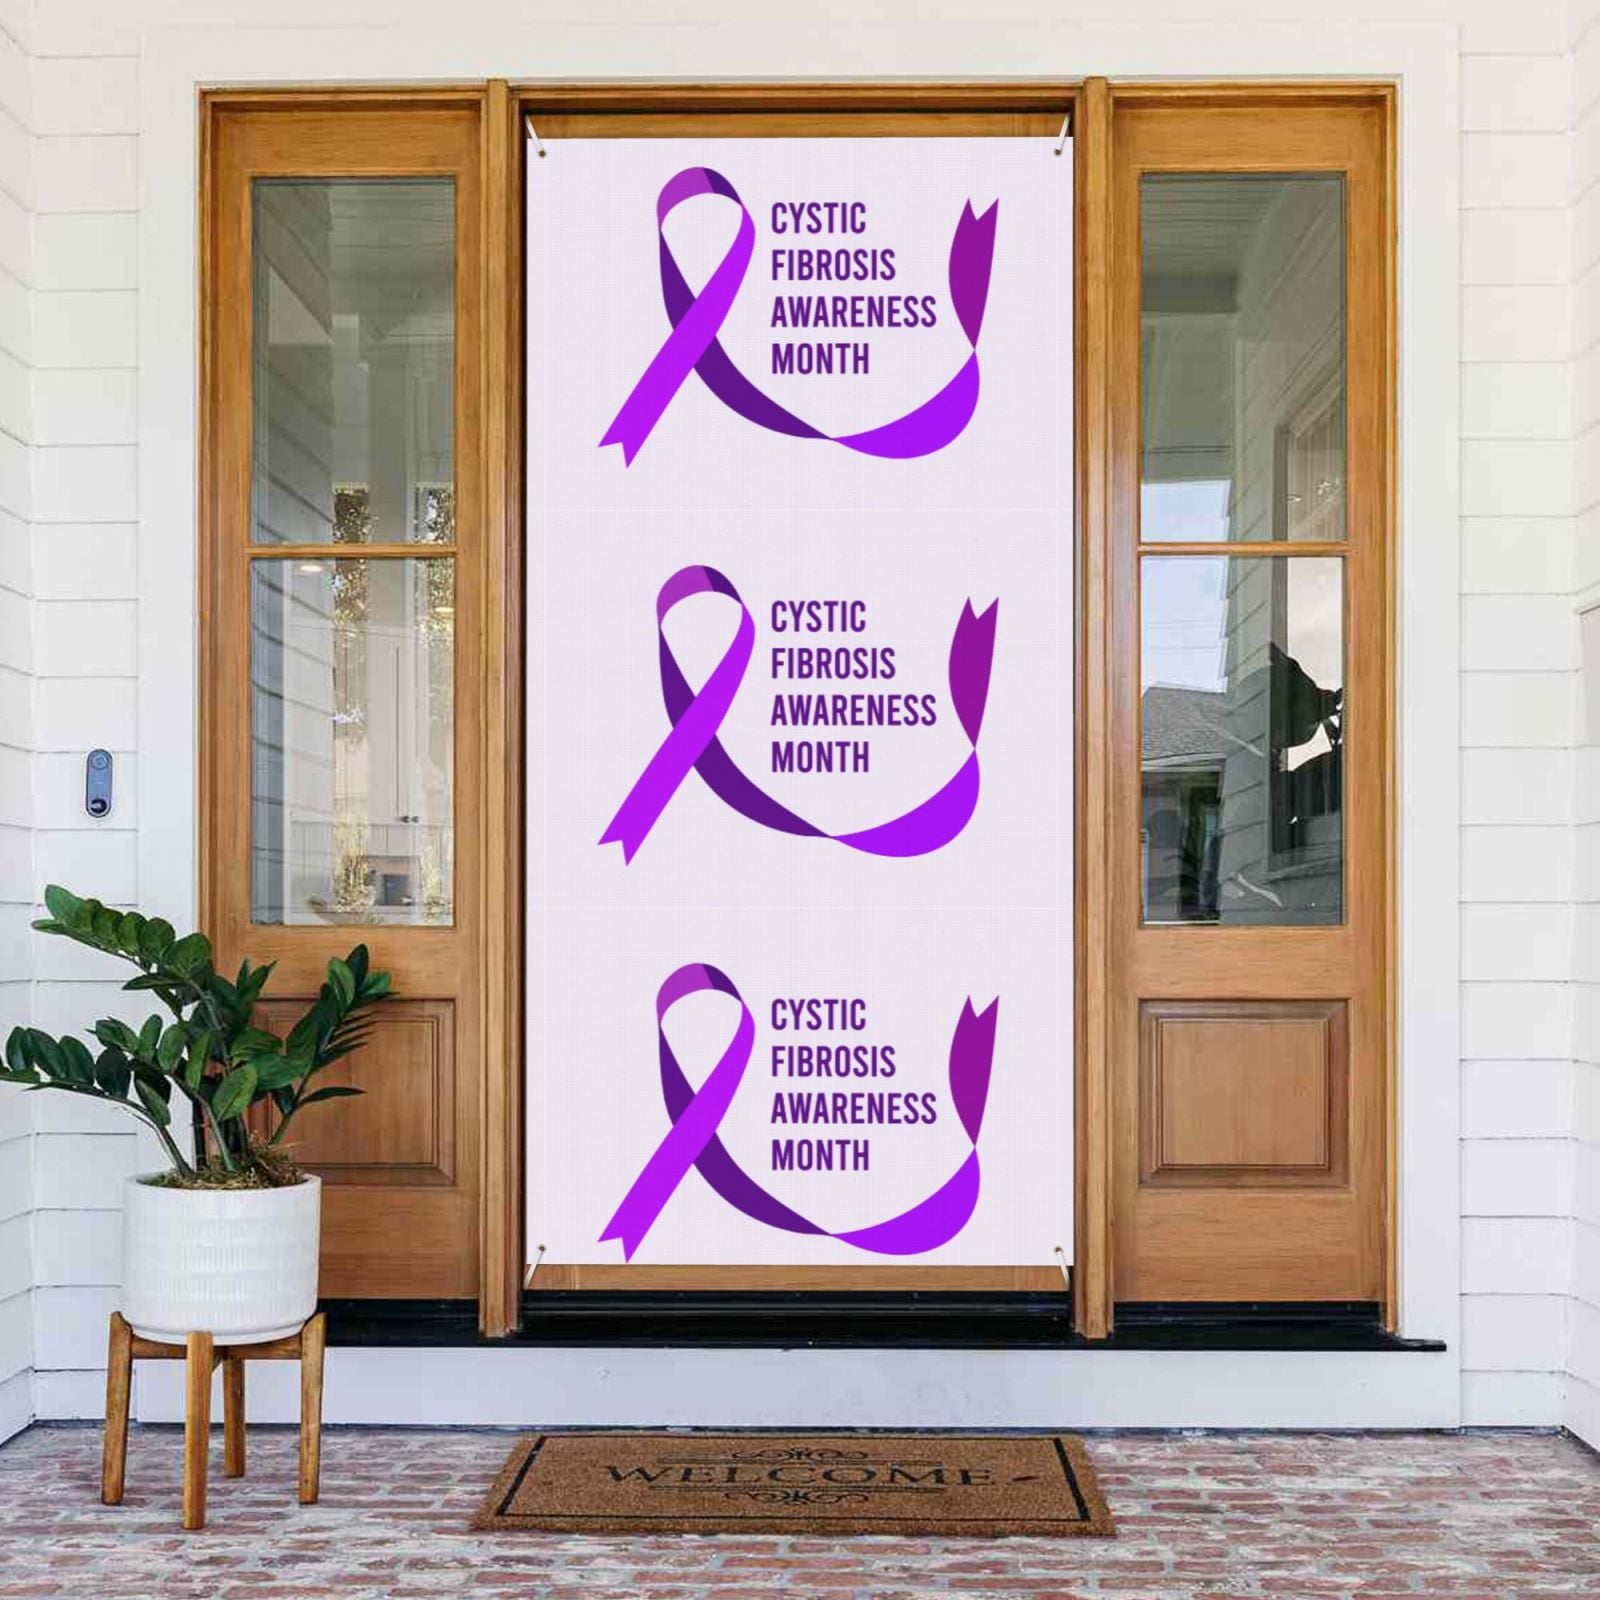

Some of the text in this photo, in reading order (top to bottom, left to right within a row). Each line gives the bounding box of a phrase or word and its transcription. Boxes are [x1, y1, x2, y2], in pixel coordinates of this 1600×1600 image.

[771, 201, 866, 235] CYSTIC
[772, 248, 896, 281] FIBROSIS
[771, 295, 937, 328] AWARENESS
[772, 342, 869, 375] MONTH
[771, 600, 866, 633] CYSTIC
[771, 647, 896, 680] FIBROSIS
[770, 694, 937, 727] AWARENESS
[771, 741, 869, 773] MONTH
[771, 998, 866, 1031] CYSTIC
[771, 1045, 896, 1078] FIBROSIS
[770, 1092, 937, 1125] AWARENESS
[771, 1139, 869, 1171] MONTH
[606, 1465, 995, 1487] WELCOME
